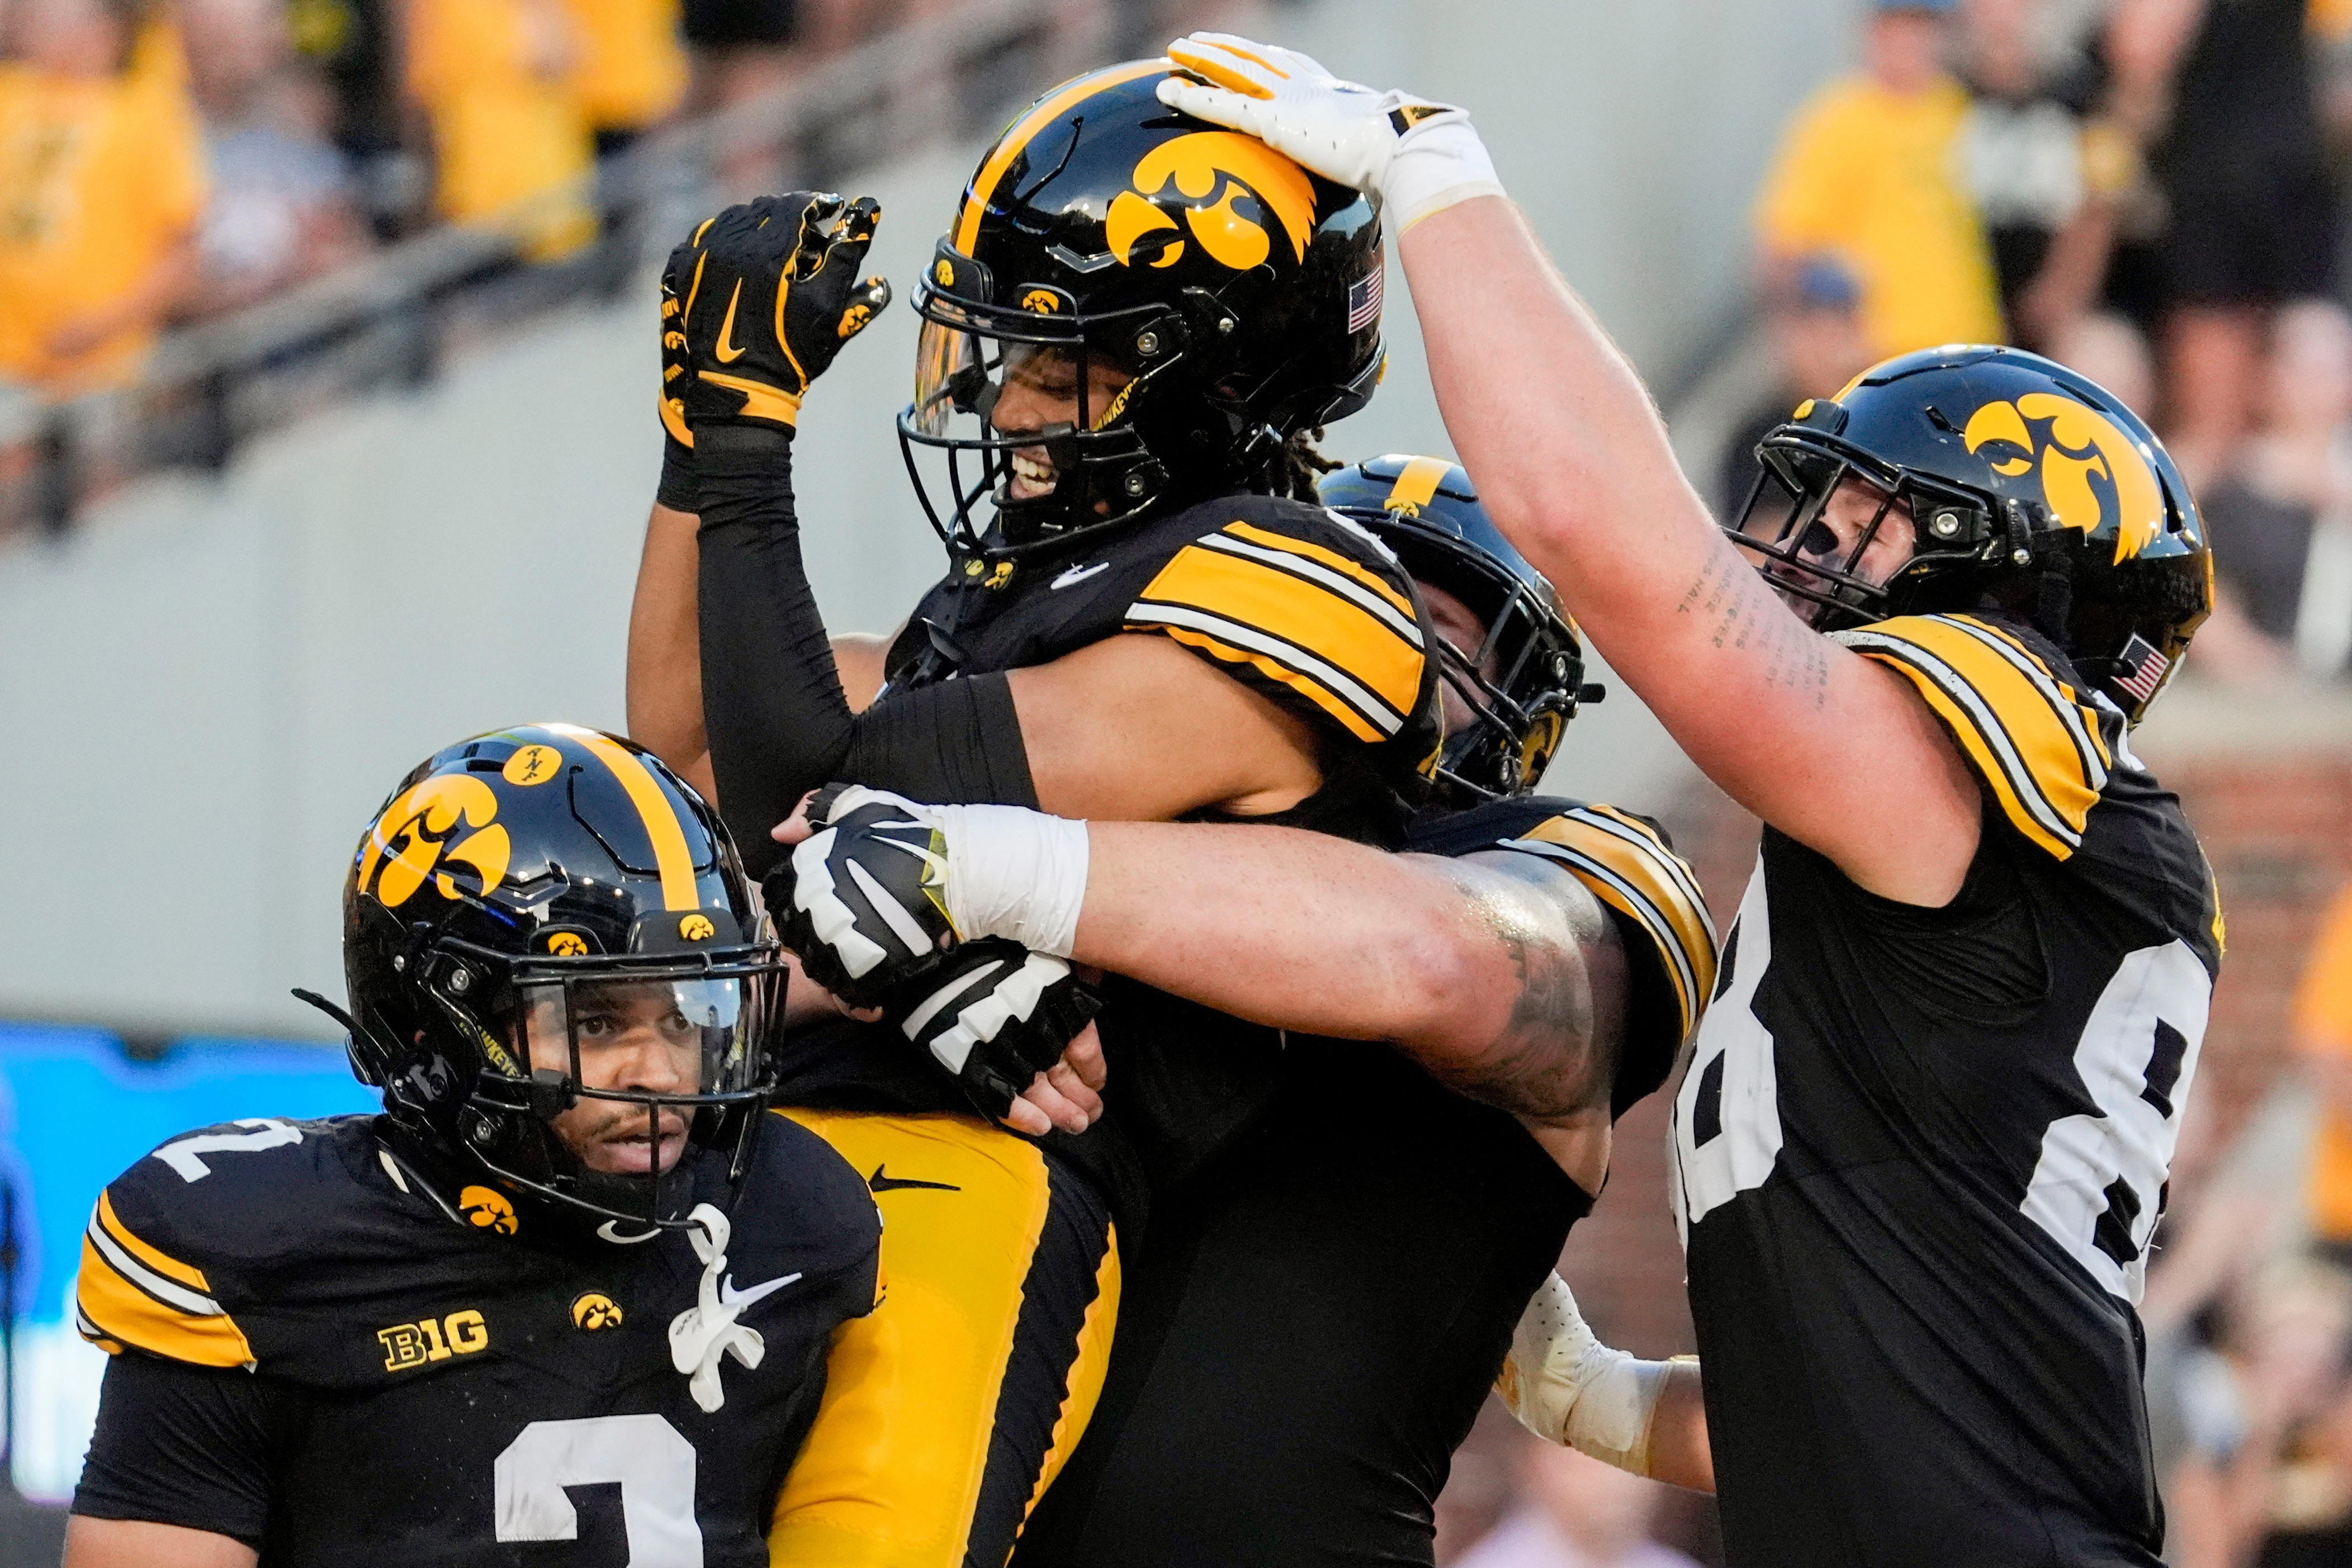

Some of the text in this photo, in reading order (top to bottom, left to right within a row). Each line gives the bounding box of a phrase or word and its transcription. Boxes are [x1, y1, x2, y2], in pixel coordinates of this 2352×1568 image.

[521, 747, 543, 781] ANF
[1667, 842, 1783, 1285] 8
[152, 1118, 304, 1183] 2
